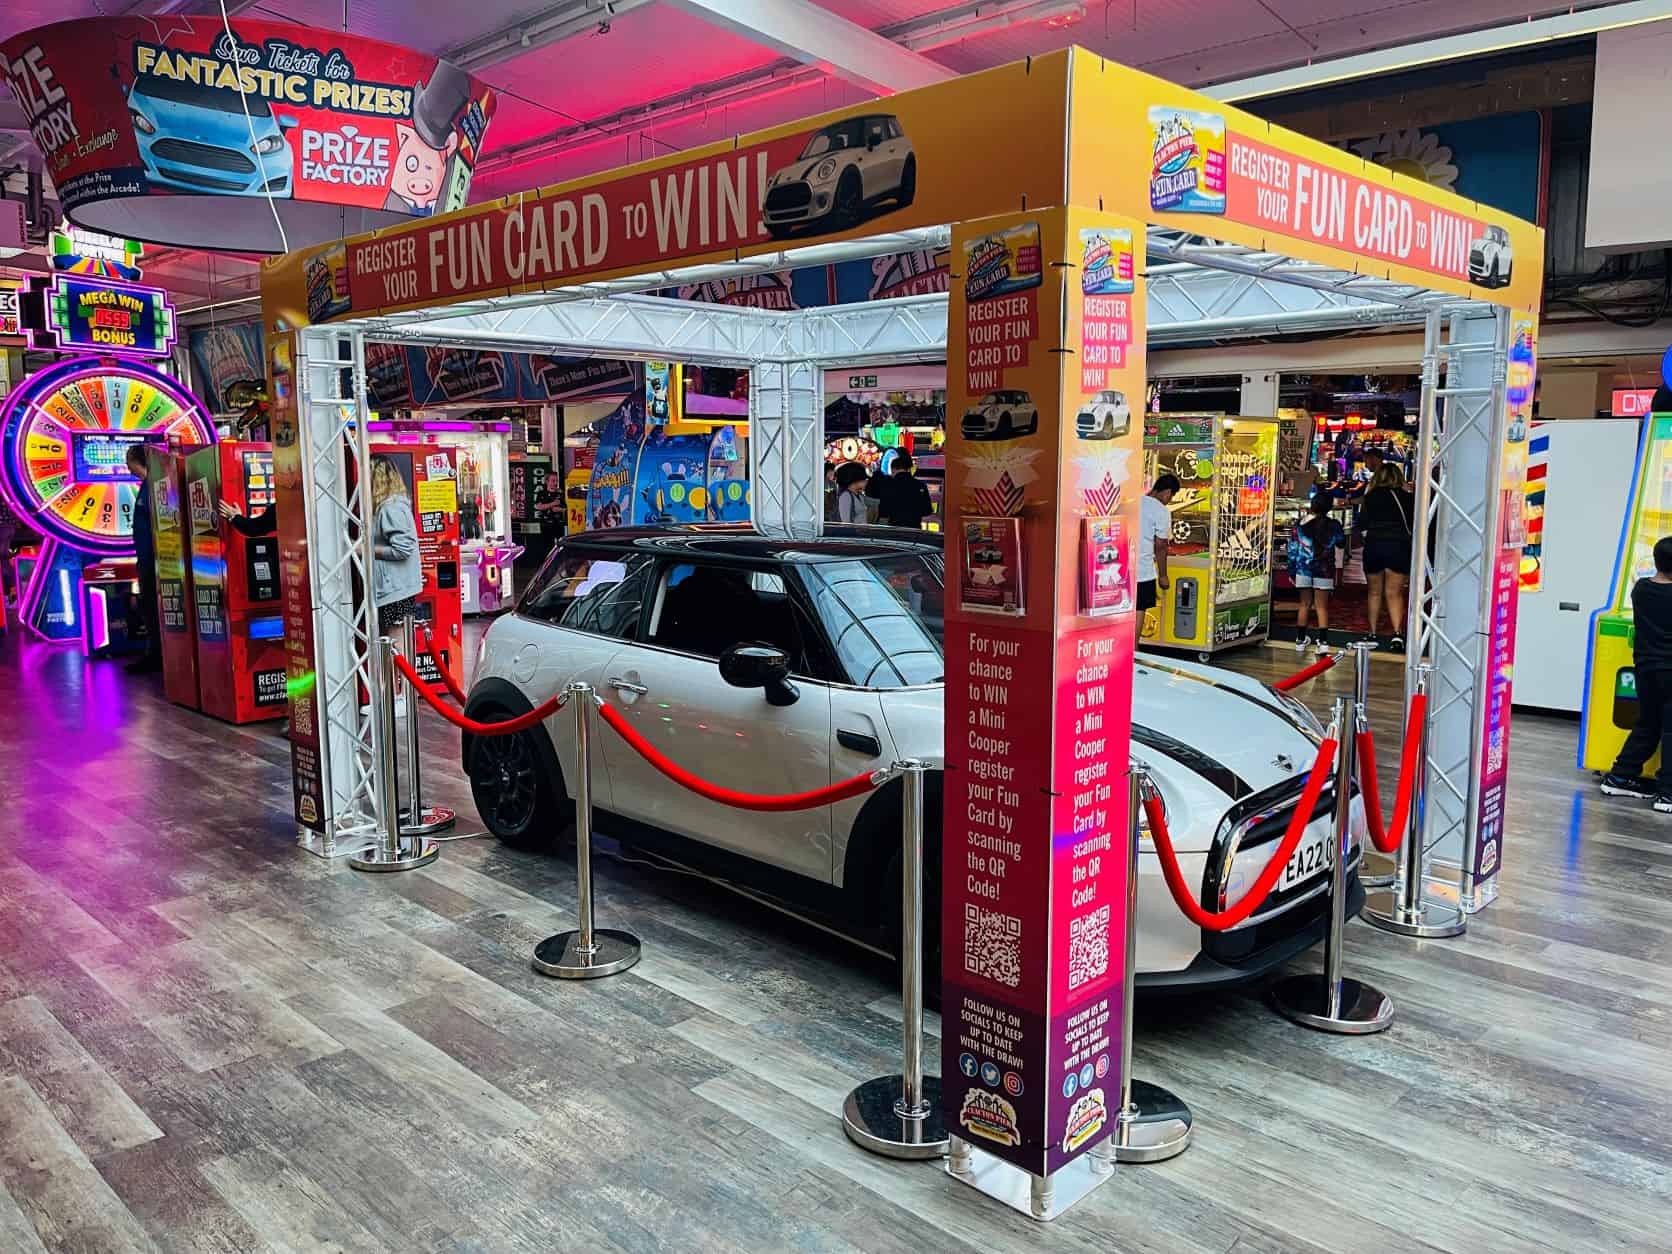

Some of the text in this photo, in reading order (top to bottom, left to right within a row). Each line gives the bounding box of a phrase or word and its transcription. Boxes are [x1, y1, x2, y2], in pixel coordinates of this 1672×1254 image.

[216, 35, 350, 79] Save Tickets for
[137, 46, 411, 115] FANTASTIC PRIZES!
[302, 162, 390, 187] FACTORY
[1231, 142, 1290, 191] REGISTER
[110, 182, 140, 194] Arcade!
[1256, 187, 1289, 225] YOUR
[1293, 164, 1347, 243] FUN
[1353, 184, 1413, 259] CARD
[1415, 220, 1427, 249] TO
[428, 152, 769, 293] FUN CARD TO WIN!
[356, 237, 416, 275] REGISTER
[382, 269, 418, 302] YOUR
[79, 291, 143, 313] MEGA WIN
[968, 297, 1029, 321] REGISTER
[1084, 298, 1127, 318] REGISTER
[92, 329, 136, 345] BONUS
[968, 320, 1030, 344] YOUR FUN
[1083, 322, 1127, 341] YOUR FUN
[968, 344, 1021, 367] CARD TO
[1083, 346, 1121, 364] CARD TO
[968, 370, 998, 389] WIN!
[1083, 369, 1105, 387] WIN!
[969, 633, 1020, 658] For your
[1077, 638, 1115, 659] For your
[969, 658, 1013, 681] chance
[1076, 663, 1109, 684] chance
[969, 683, 1008, 705] to WIN
[1076, 685, 1105, 710] to WIN
[968, 707, 1005, 730] a Mini
[1075, 710, 1103, 734] a Mini
[968, 730, 1011, 756] Cooper
[1075, 737, 1106, 760] Cooper
[968, 758, 1015, 781] register
[1074, 761, 1108, 786] register
[967, 783, 1020, 808] your Fun
[1073, 783, 1111, 813] your Fun
[967, 802, 1013, 834] Card by
[1073, 809, 1107, 834] Card by
[967, 831, 1022, 862] scanning
[1072, 832, 1112, 859] scanning
[967, 851, 1006, 879] the QR
[1072, 856, 1101, 883] the QR
[1286, 841, 1323, 882] EA22
[967, 874, 1000, 900] Code!
[1072, 882, 1097, 908] Code!
[960, 1009, 1024, 1042] SOCIALS TO KEEP
[963, 997, 1021, 1029] FOLLOW US ON
[969, 1025, 1013, 1051] UP TO DATE
[1065, 1024, 1088, 1044] SOCIALS
[1071, 1040, 1080, 1053] UP
[960, 1035, 1024, 1071] WITH THE DRAW!
